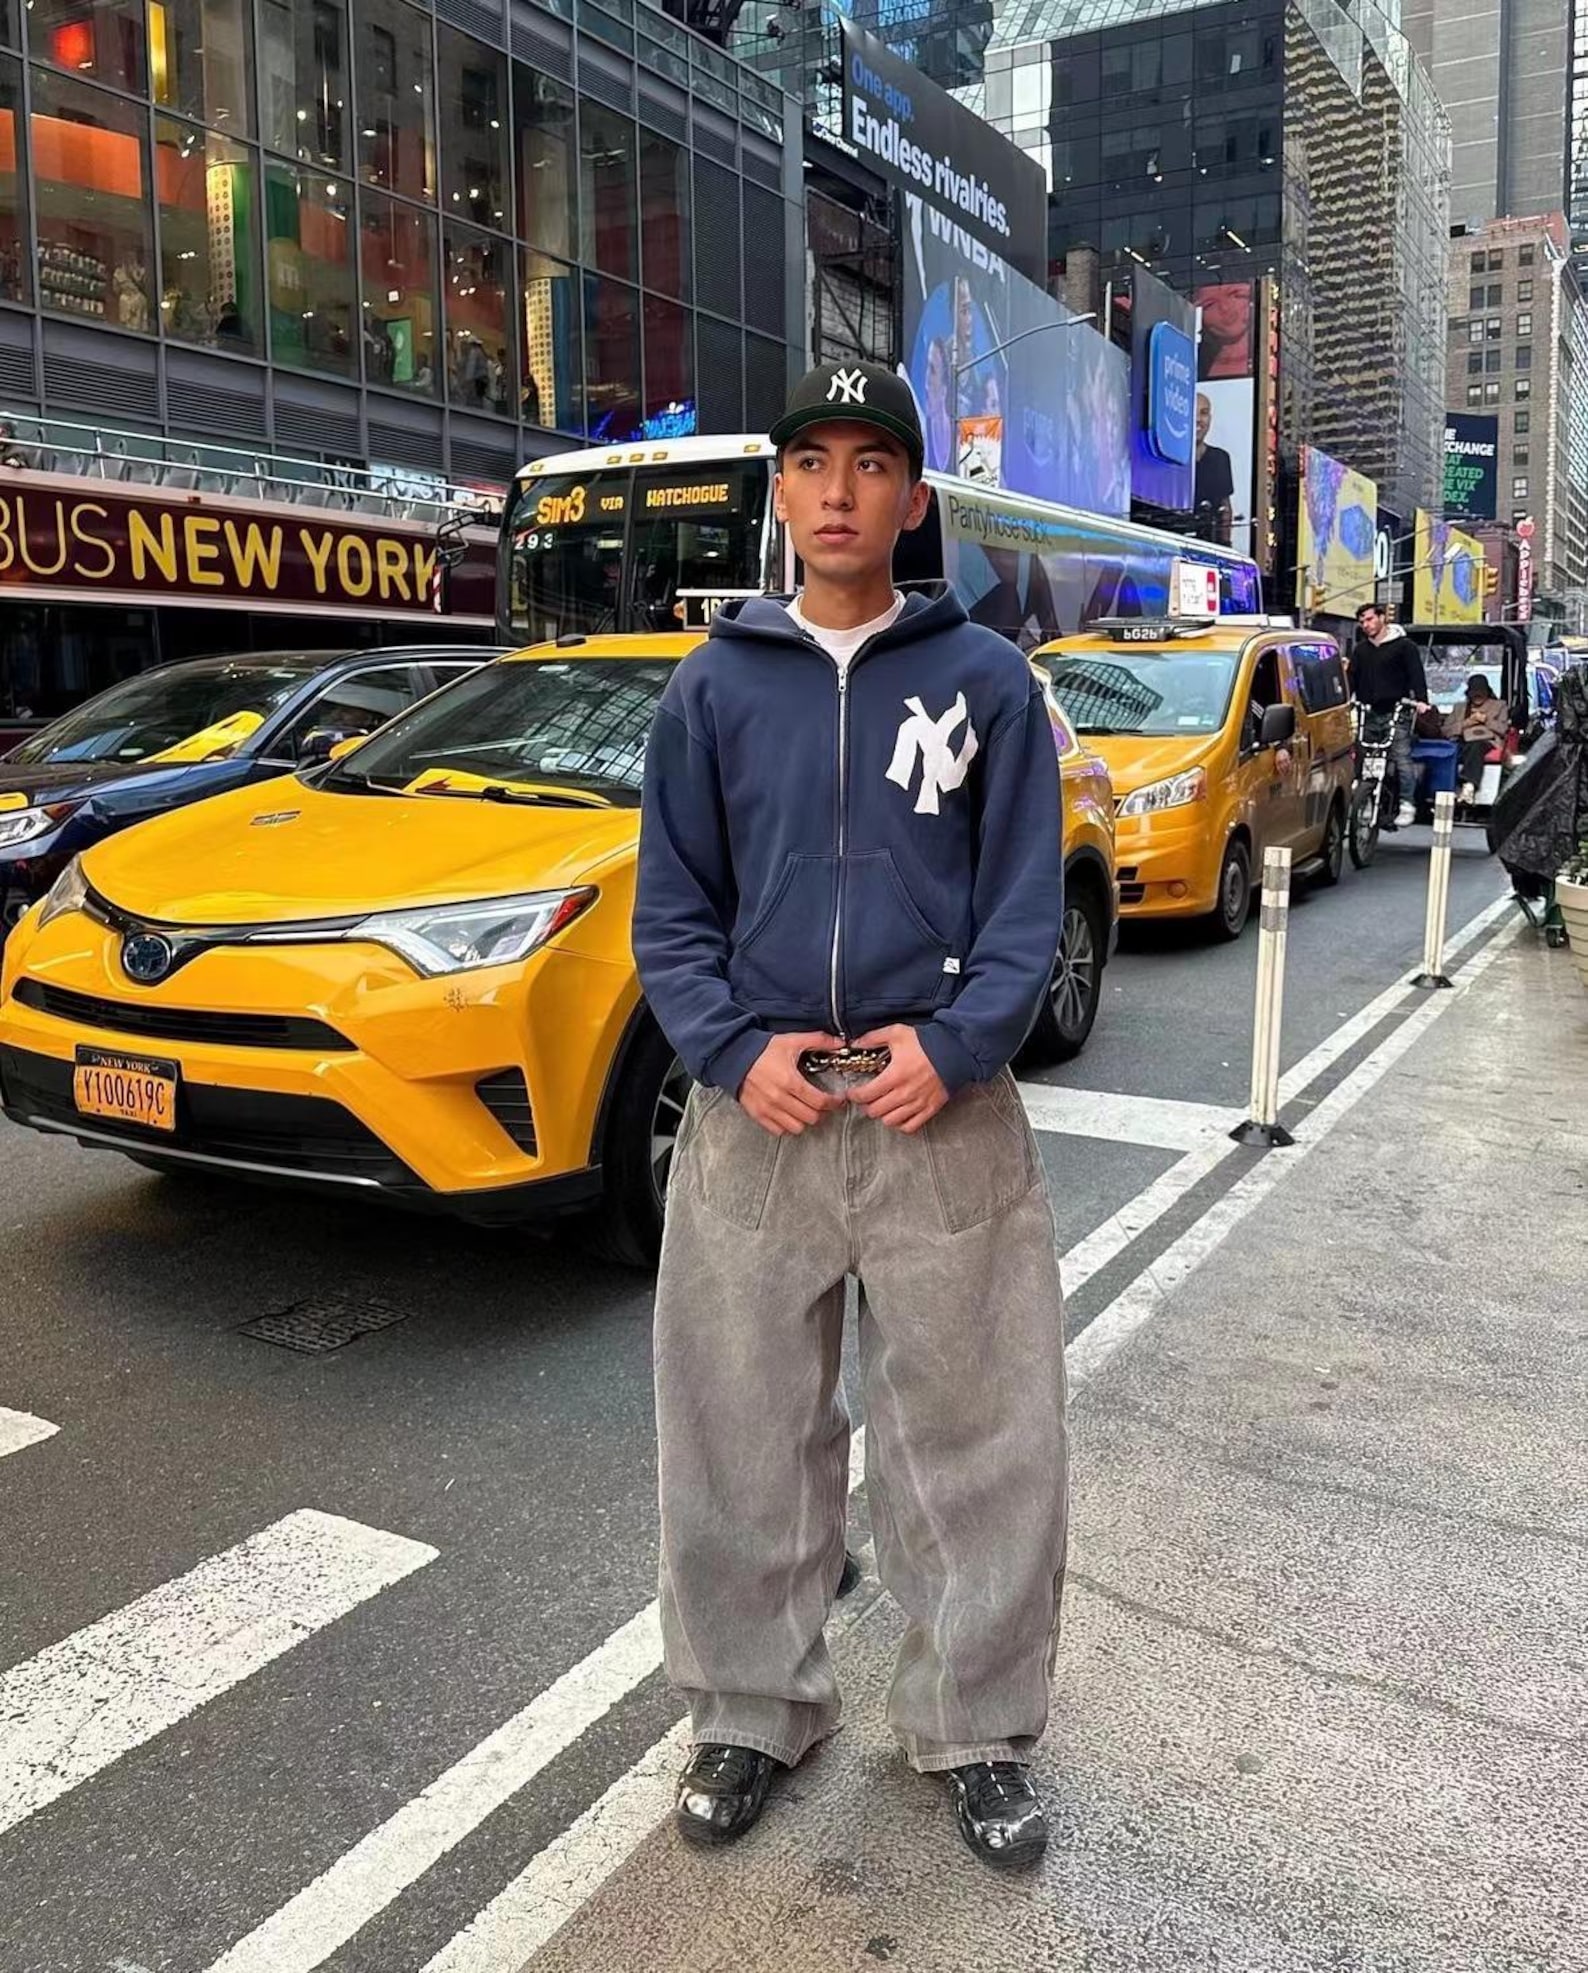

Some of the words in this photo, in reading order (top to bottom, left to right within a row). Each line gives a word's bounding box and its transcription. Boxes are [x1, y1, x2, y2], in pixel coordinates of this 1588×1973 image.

[851, 52, 882, 98] One
[884, 83, 915, 122] app.
[852, 94, 933, 188] Endless
[934, 156, 1010, 237] rivalries.
[826, 367, 868, 404] NY
[1164, 352, 1190, 386] prime
[1164, 382, 1189, 417] video
[537, 485, 586, 525] SIM3
[601, 496, 624, 510] VIA
[128, 509, 283, 590] NEW
[885, 690, 979, 816] NY
[100, 1058, 124, 1069] NEW
[126, 1060, 151, 1073] YORK
[84, 1069, 165, 1115] Y100619C
